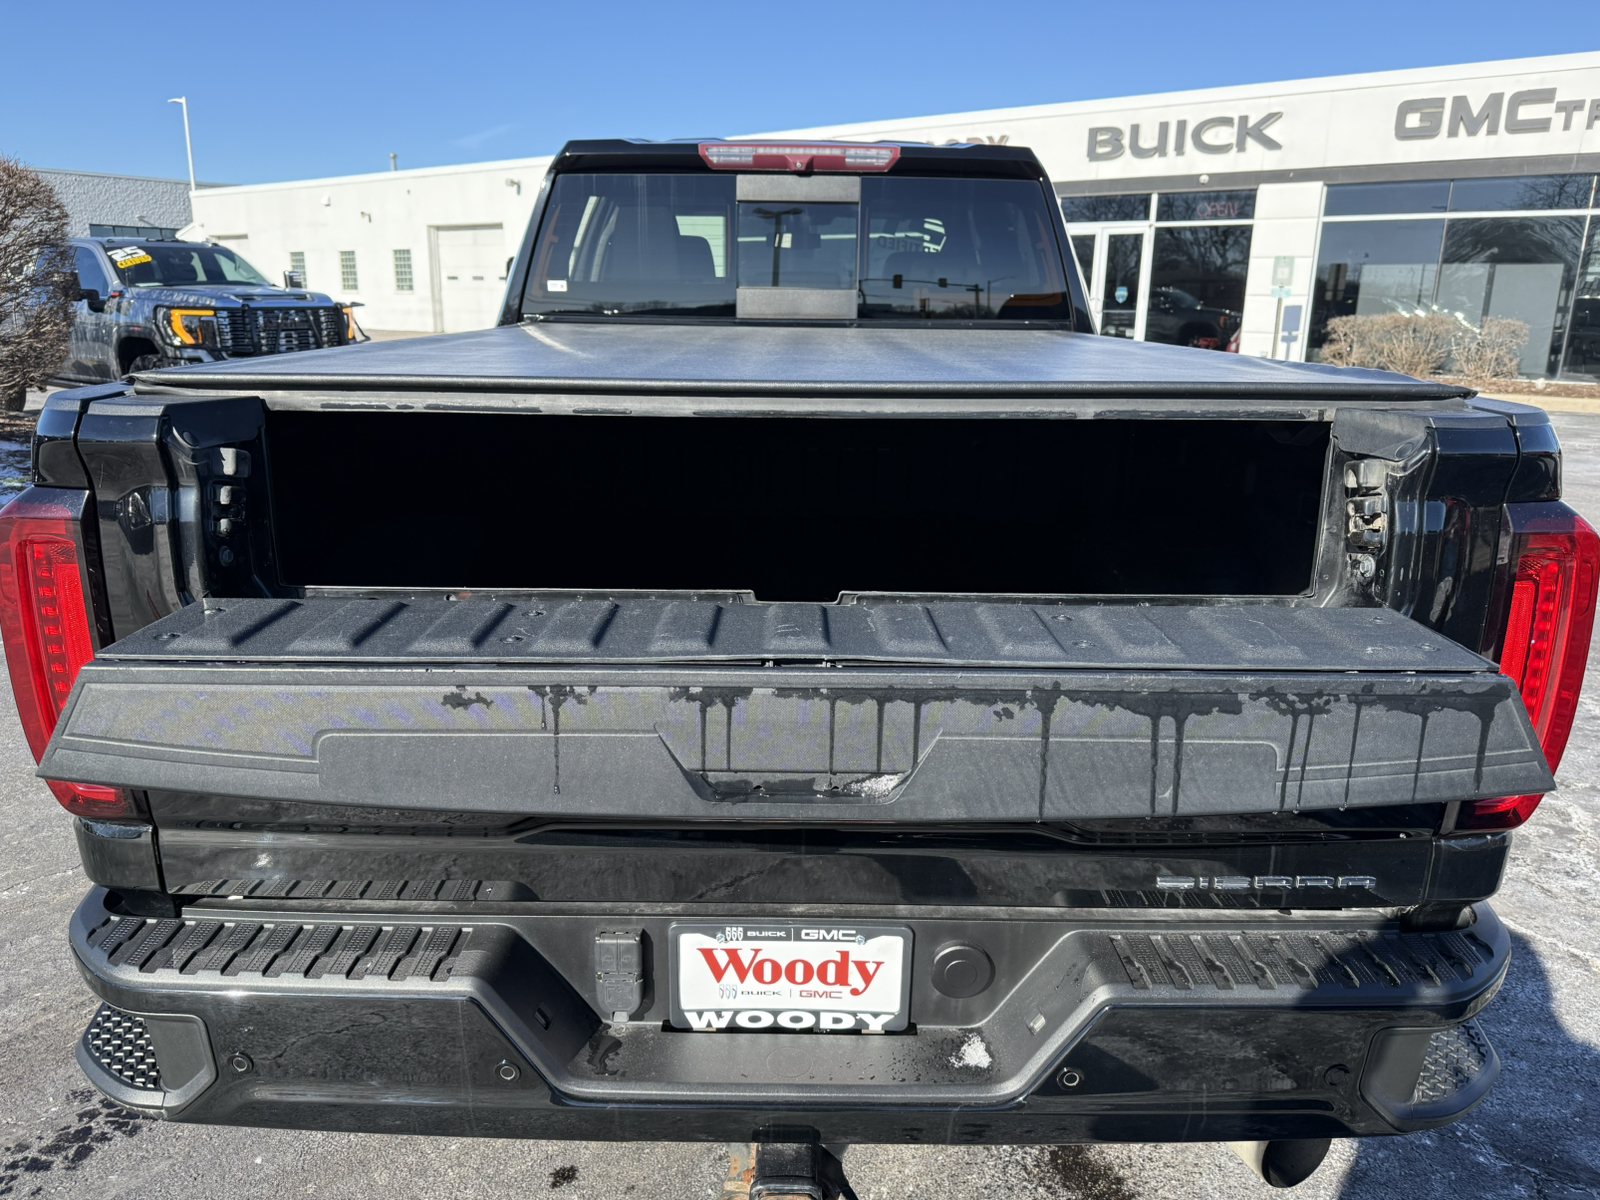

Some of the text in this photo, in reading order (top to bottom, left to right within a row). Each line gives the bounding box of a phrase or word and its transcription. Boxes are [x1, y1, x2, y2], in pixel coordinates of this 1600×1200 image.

[1395, 87, 1557, 140] GMC
[1087, 111, 1283, 162] BUICK
[1197, 201, 1239, 218] OPEN
[106, 246, 146, 261] 25
[800, 929, 857, 941] GMC
[697, 948, 885, 997] Woody
[799, 989, 843, 999] GMC
[683, 1010, 898, 1030] WOODY
